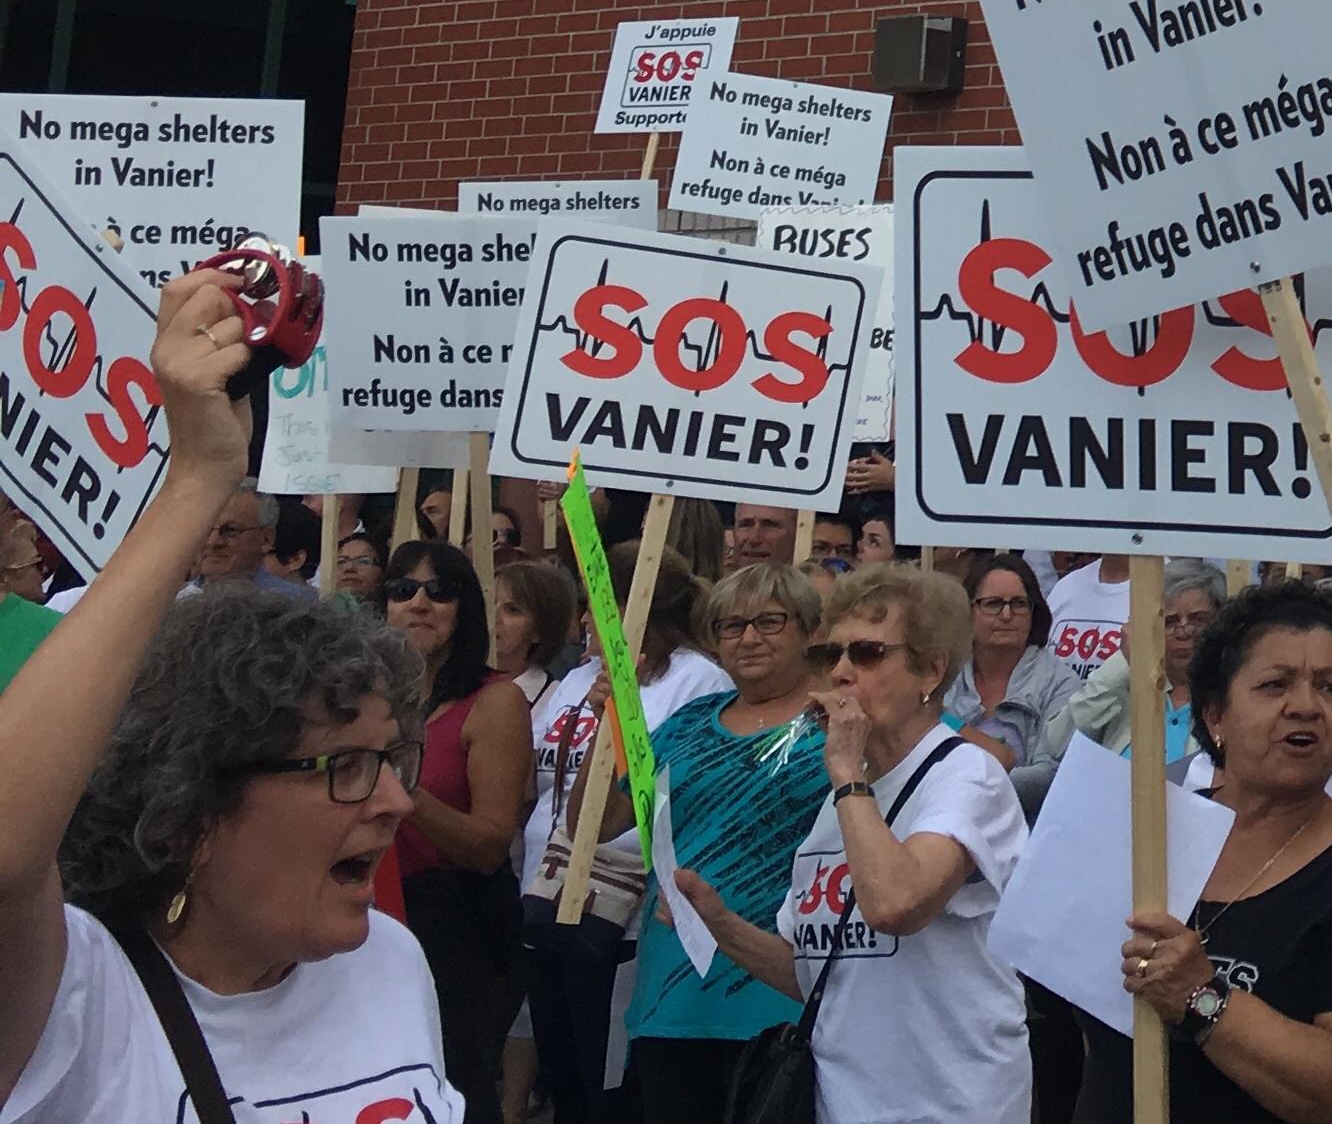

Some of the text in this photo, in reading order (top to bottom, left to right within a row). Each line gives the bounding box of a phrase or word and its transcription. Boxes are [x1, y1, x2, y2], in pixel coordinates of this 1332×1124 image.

[645, 23, 716, 41] J'appuie
[1094, 19, 1135, 70] in
[633, 50, 704, 83] SOS
[614, 110, 688, 128] Support
[710, 81, 872, 122] No mega shelters
[20, 110, 275, 148] No mega shelters
[740, 117, 831, 146] in Vanier!
[710, 149, 846, 189] Non à ce méga
[1085, 131, 1166, 190] Non
[1163, 114, 1193, 161] à
[1198, 112, 1238, 156] ce
[75, 157, 215, 188] in Vanier!
[478, 191, 640, 215] No mega shelters
[681, 179, 743, 206] refuge
[748, 186, 792, 206] dans
[130, 225, 162, 245] ce
[348, 233, 388, 262] No
[397, 242, 473, 270] mega
[773, 225, 872, 261] BUSES
[1077, 221, 1191, 286] refuge
[1199, 192, 1282, 251] dans
[405, 279, 431, 307] in
[374, 334, 430, 364] Non
[438, 337, 454, 364] à
[463, 343, 492, 364] ce
[559, 283, 834, 404] SOS
[342, 378, 504, 415] refuge dans
[545, 392, 816, 470] VANIER!
[0, 372, 121, 540] NIER!
[945, 413, 1312, 500] VANIER!
[1055, 628, 1121, 661] SOS
